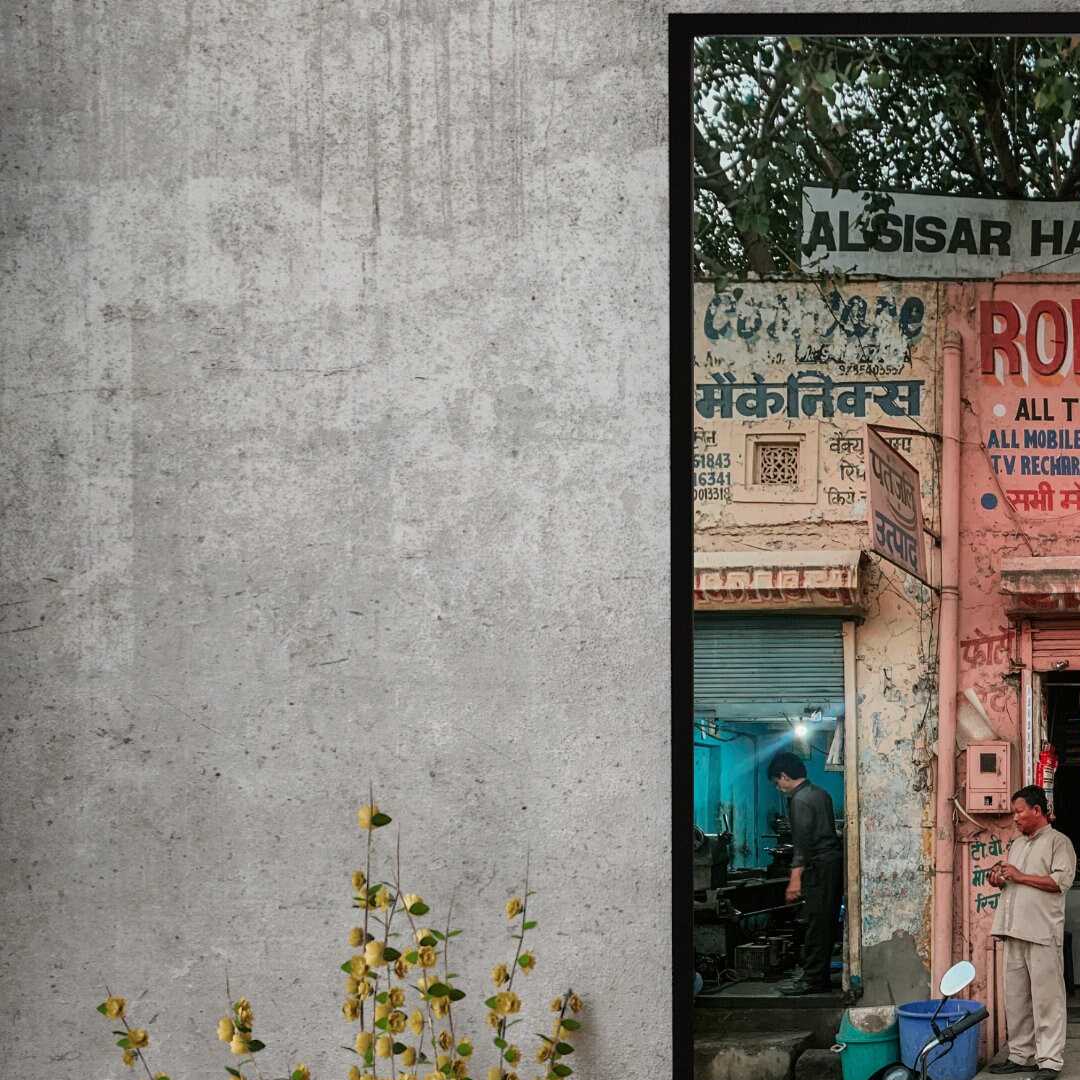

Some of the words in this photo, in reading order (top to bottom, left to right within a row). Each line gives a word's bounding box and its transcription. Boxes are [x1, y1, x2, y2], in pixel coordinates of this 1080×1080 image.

[808, 211, 1011, 255] ALSISAR
[1015, 398, 1055, 421] ALL
[987, 429, 1020, 449] ALL
[1006, 480, 1055, 513] सभी
[875, 509, 918, 572] उत्पाद
